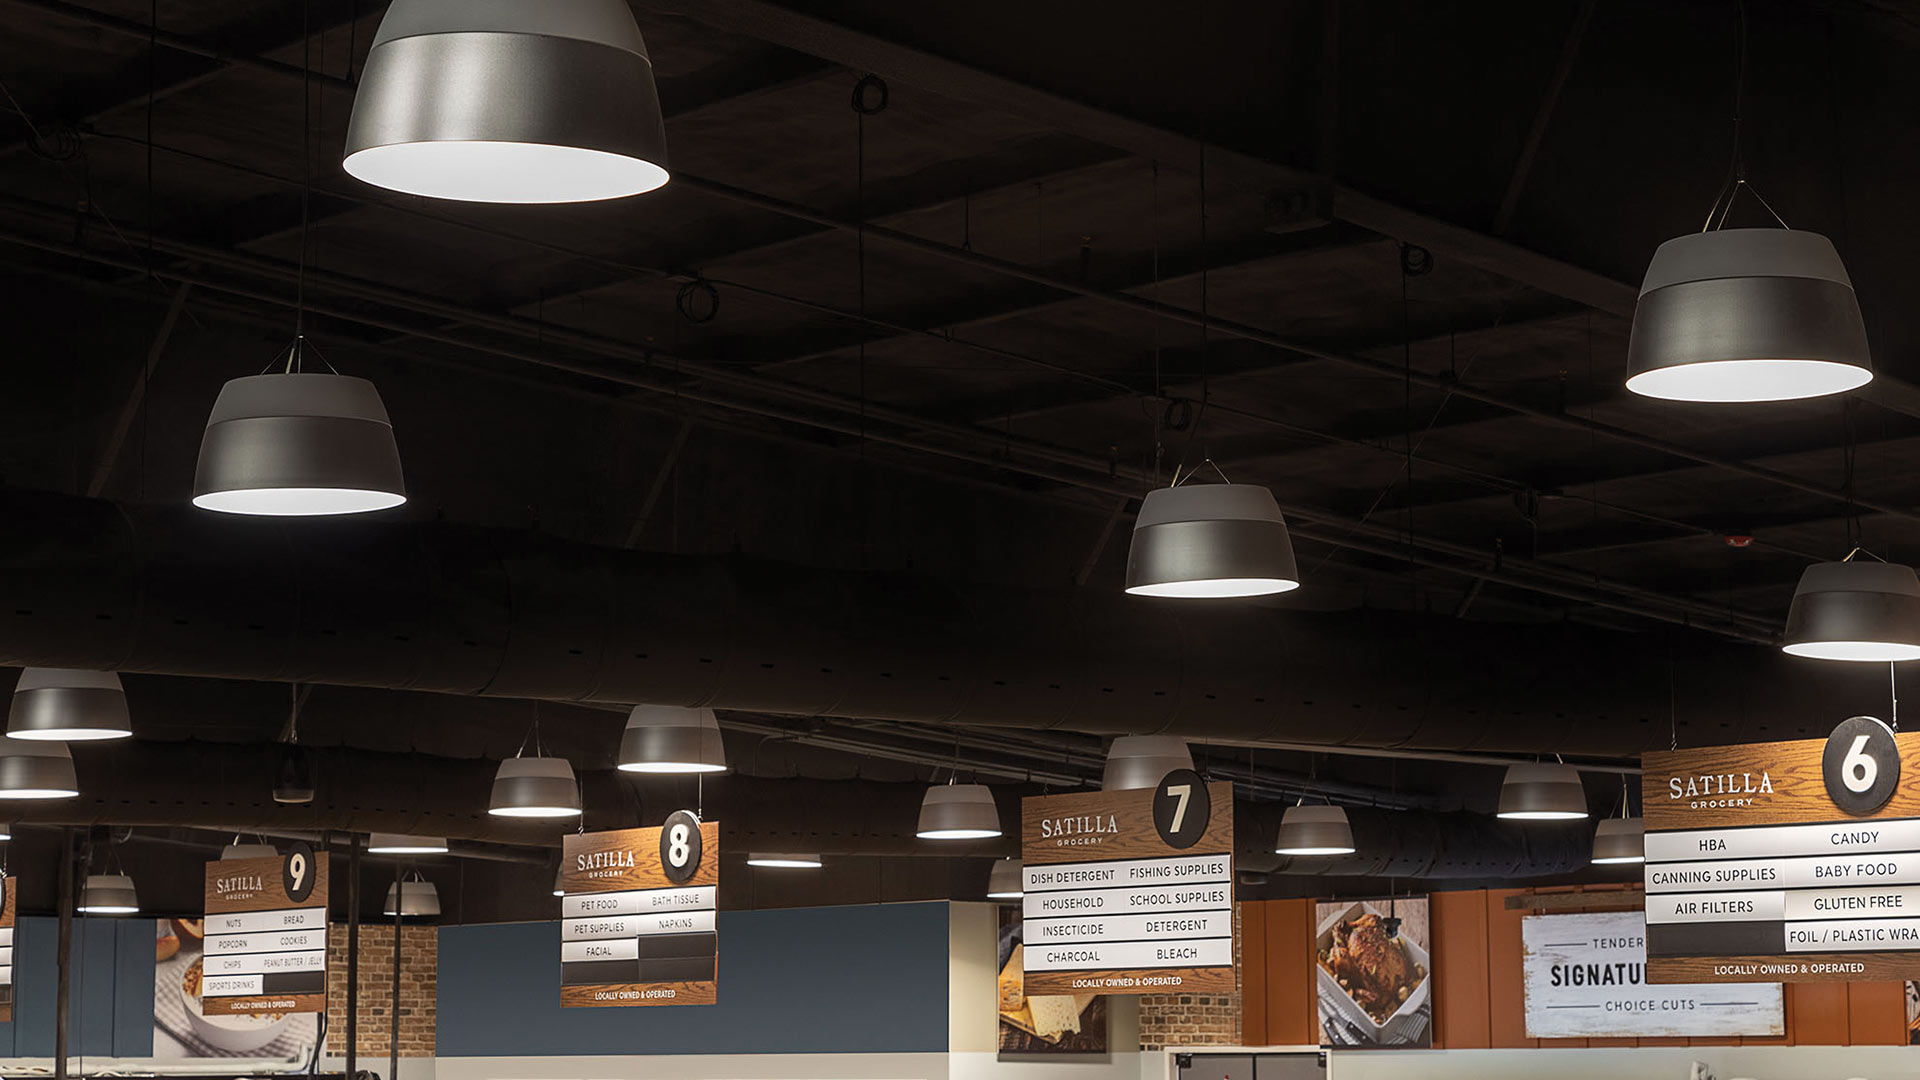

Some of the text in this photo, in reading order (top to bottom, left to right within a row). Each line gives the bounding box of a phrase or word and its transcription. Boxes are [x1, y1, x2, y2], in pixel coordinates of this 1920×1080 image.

[1842, 735, 1878, 793] 6
[1669, 772, 1774, 799] SATILLA
[1167, 784, 1191, 833] 7
[1690, 798, 1753, 809] GROCERY
[1042, 815, 1118, 838] SATILLA
[1057, 837, 1103, 847] GROCERY
[1831, 831, 1879, 845] CANDY
[669, 824, 690, 868] 8
[1700, 839, 1726, 851] HBA
[577, 851, 634, 870] SATILLA
[290, 853, 306, 890] 9
[1130, 863, 1224, 878] FISHING SUPPLIES
[1652, 868, 1776, 885] CANNING SUPPLIES
[1816, 863, 1897, 878] BABY FOOD
[1031, 870, 1115, 884] DISH DETERGENT
[217, 876, 262, 893] SATILLA
[652, 894, 699, 906] BATH TISSUE
[1043, 897, 1104, 910] HOUSEHOLD
[1130, 891, 1224, 906] SCHOOL SUPPLIES
[1814, 896, 1902, 910] GLUTEN FREE
[581, 900, 618, 910] PET FOOD
[1675, 901, 1753, 915] AIR FILTERS
[226, 920, 241, 928] NUTS
[284, 916, 304, 924] BREAD
[659, 918, 692, 928] NAPKINS
[1146, 919, 1208, 932] DETERGENT
[575, 923, 624, 934] PET SUPPLIES
[1043, 924, 1104, 936] INSECTICIDE
[280, 936, 307, 945] COOKIES
[1790, 927, 1919, 943] FOIL / PLASTIC WRA
[219, 940, 247, 948] POPCORN
[1593, 938, 1643, 948] TENDER
[586, 947, 612, 956] FACIAL
[1047, 951, 1100, 962] CHARCOAL
[1157, 948, 1197, 959] BLEACH
[224, 961, 241, 969] CHIPS
[264, 959, 283, 967] PEANUT
[1715, 963, 1864, 975] LOCALLY OWNED & OPERATED
[1551, 963, 1647, 986] SIGNATU
[209, 981, 254, 990] SPORTS DRINKS
[1072, 979, 1104, 988] LOCALLY
[1106, 978, 1134, 987] OWNED
[1142, 977, 1182, 986] OPERATED
[595, 991, 619, 1000] LOCALLY
[619, 991, 640, 999] OWNED
[646, 990, 676, 999] OPERATED
[1605, 1000, 1695, 1011] CHOICE CUTS
